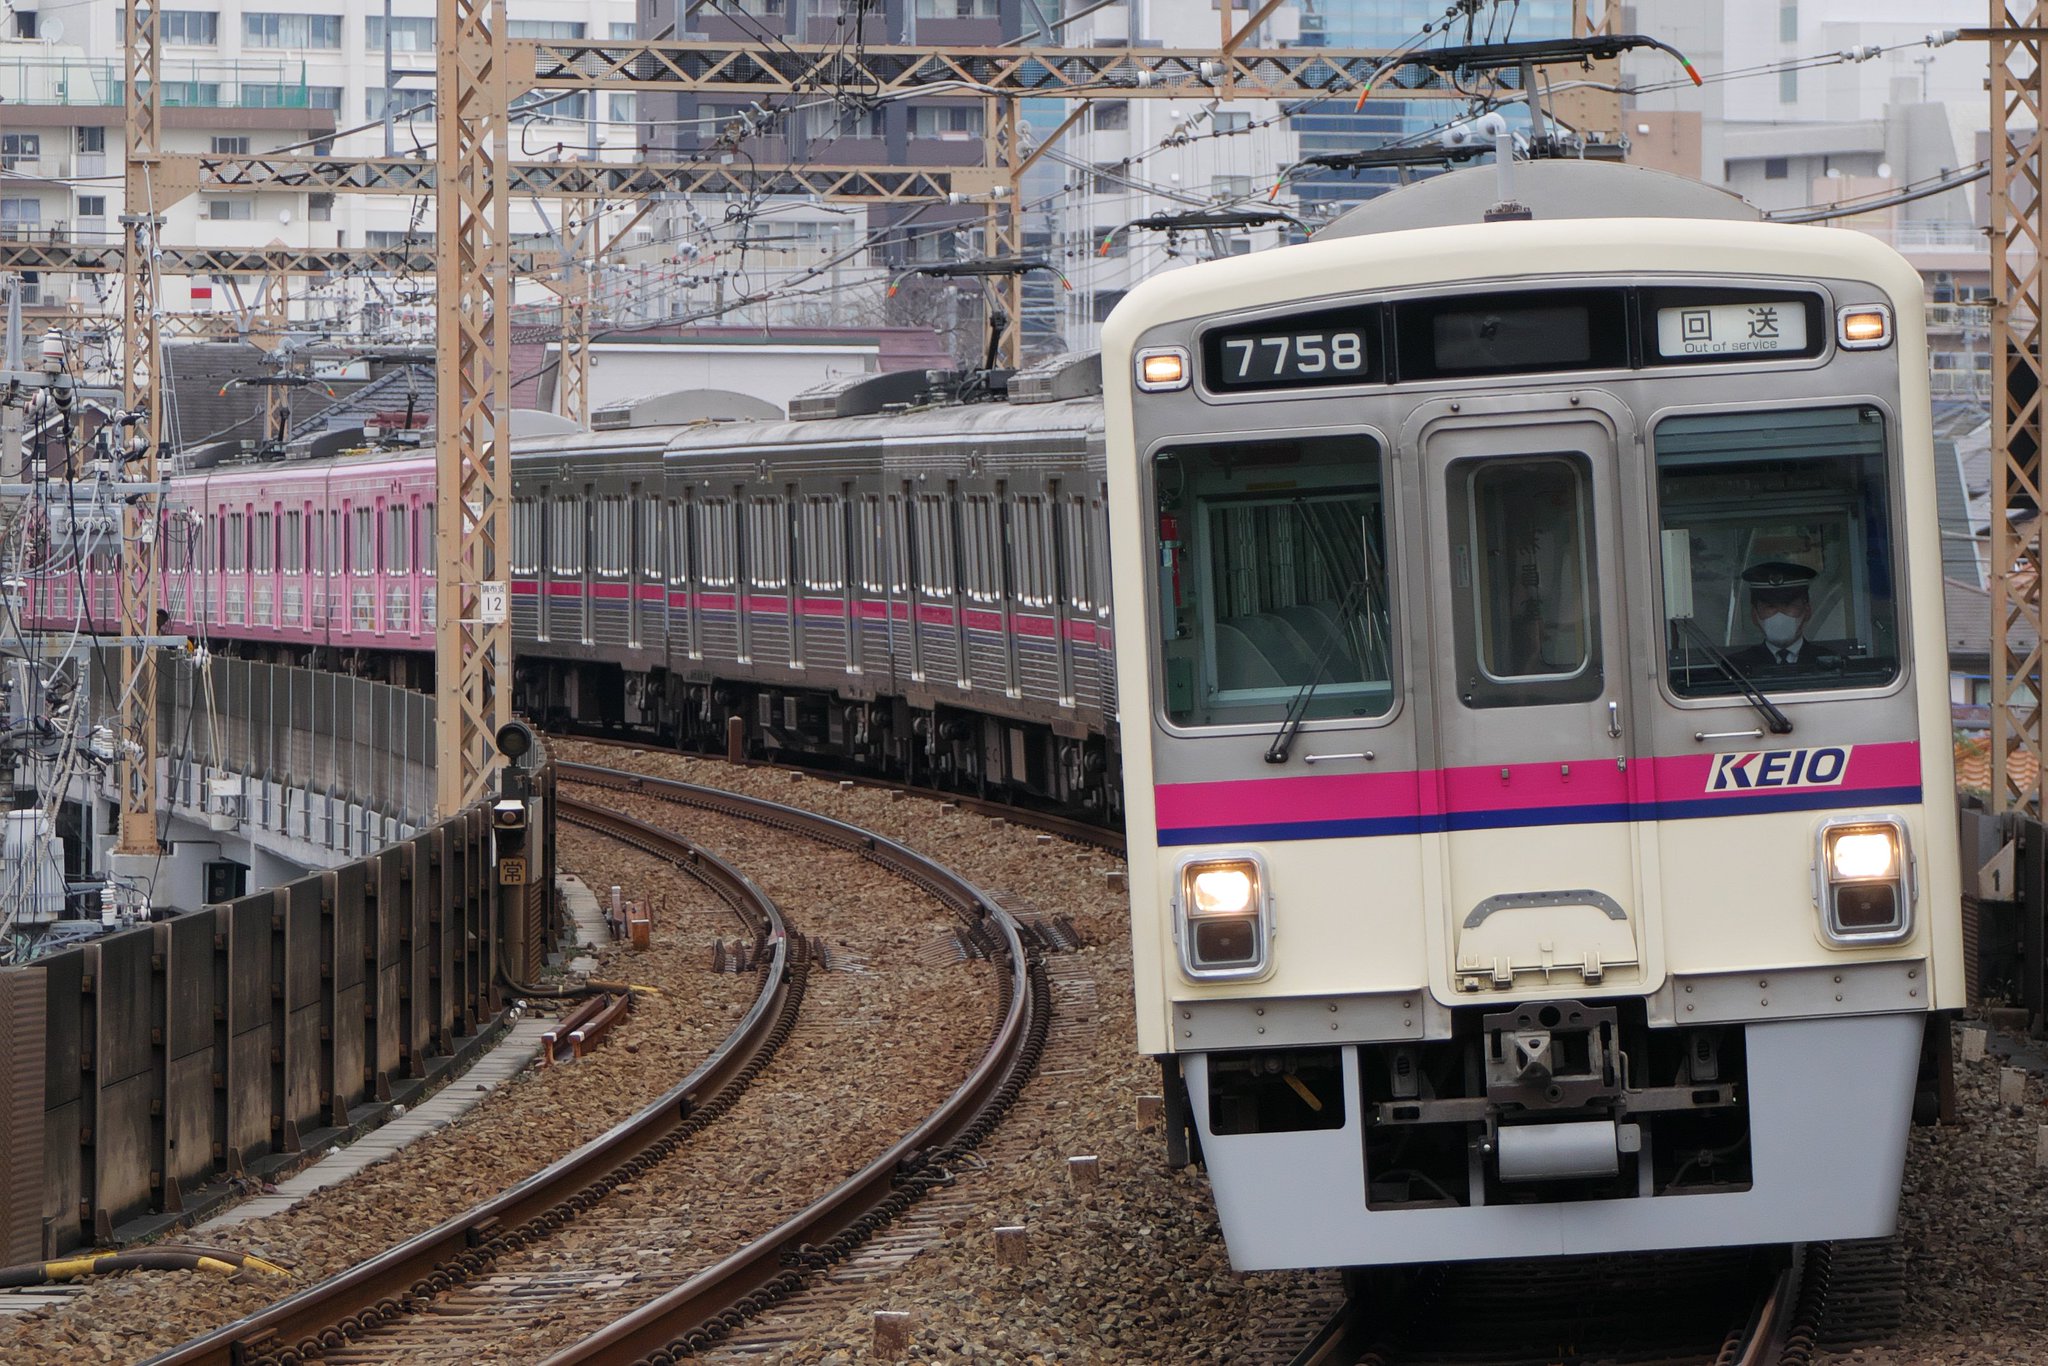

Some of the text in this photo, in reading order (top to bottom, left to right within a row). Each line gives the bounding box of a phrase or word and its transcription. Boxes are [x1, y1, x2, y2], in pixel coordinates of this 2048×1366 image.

[1681, 307, 1779, 342] 回送
[1226, 333, 1361, 377] 7758
[1684, 340, 1778, 354] Out of service
[487, 597, 502, 611] 12
[1713, 748, 1845, 790] KEIO
[503, 861, 523, 882] 常
[1992, 869, 2000, 891] 1
